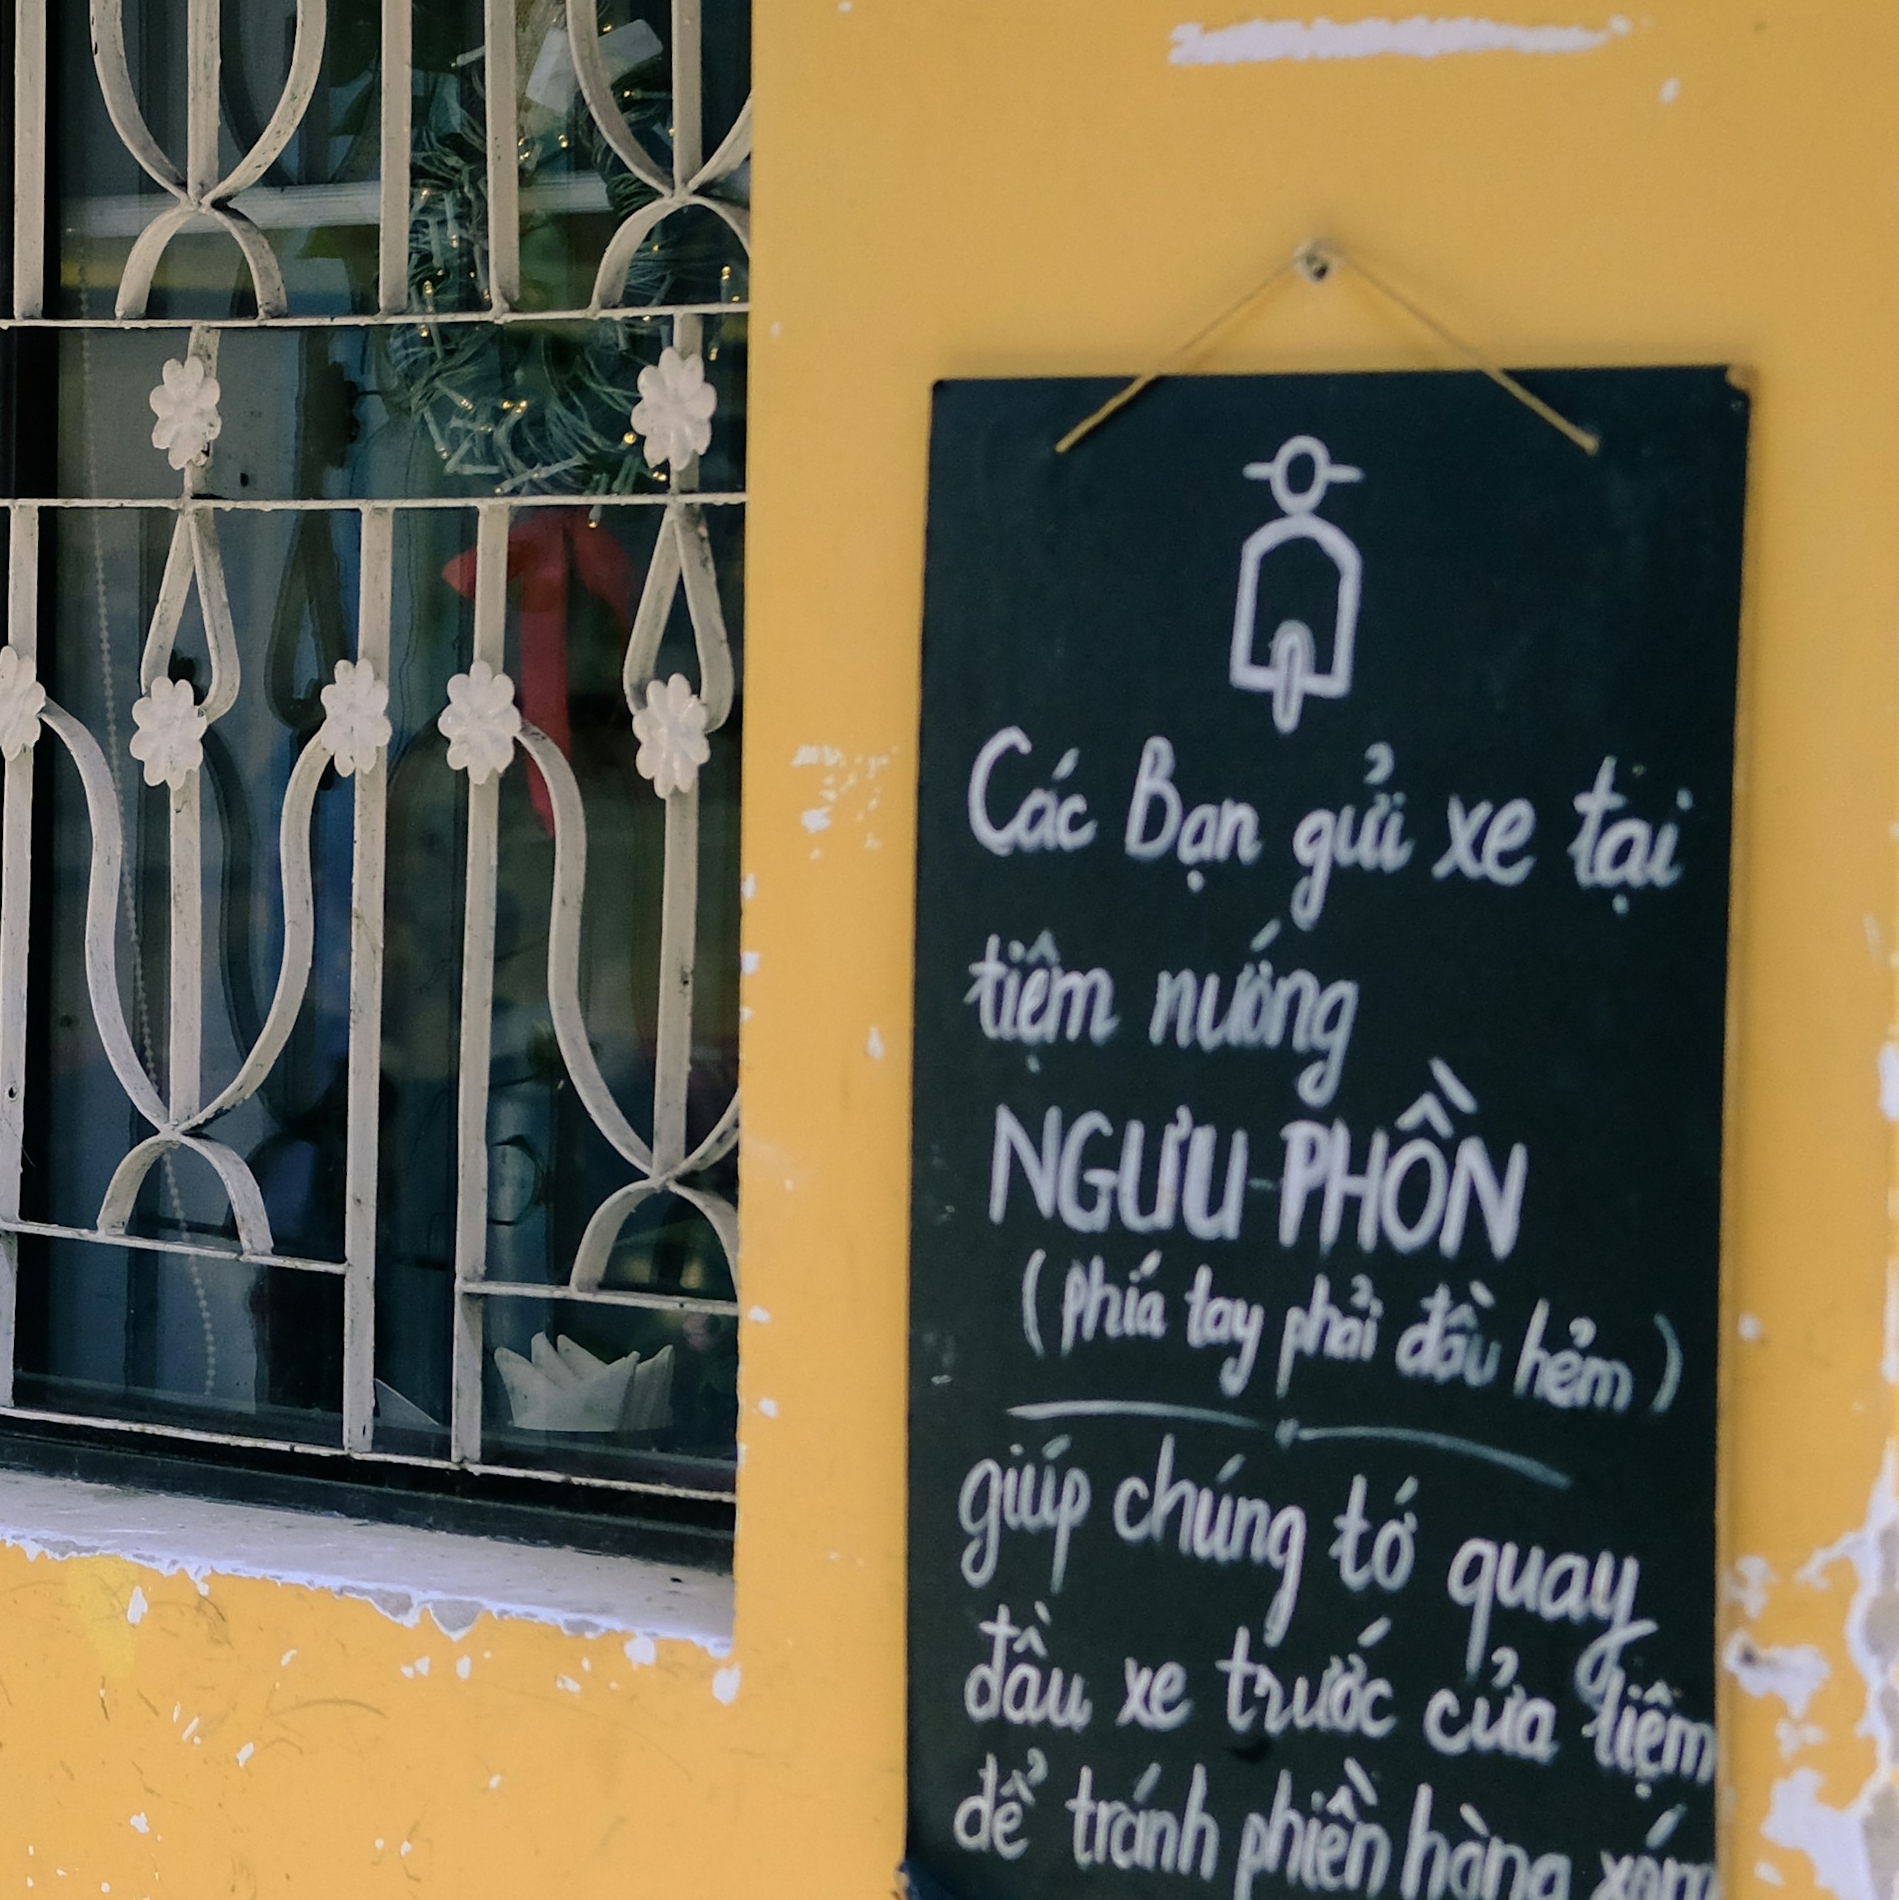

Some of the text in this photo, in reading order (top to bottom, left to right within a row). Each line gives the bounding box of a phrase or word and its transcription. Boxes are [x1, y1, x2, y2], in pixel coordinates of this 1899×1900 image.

[966, 725, 1099, 857] Các
[1125, 735, 1263, 892] Bạn
[1431, 793, 1538, 887] xe
[1569, 755, 1694, 915] tại
[963, 929, 1121, 1075] tiệm
[1185, 1264, 1264, 1397] tay
[1276, 1273, 1384, 1399] phải
[957, 1433, 1659, 1704] giúp chúng tớ quay
[964, 1601, 1094, 1732] đầu
[1115, 1656, 1194, 1732] xe
[1215, 1616, 1398, 1740] trước
[1423, 1646, 1562, 1765] cửa
[1064, 1762, 1221, 1883] tránh
